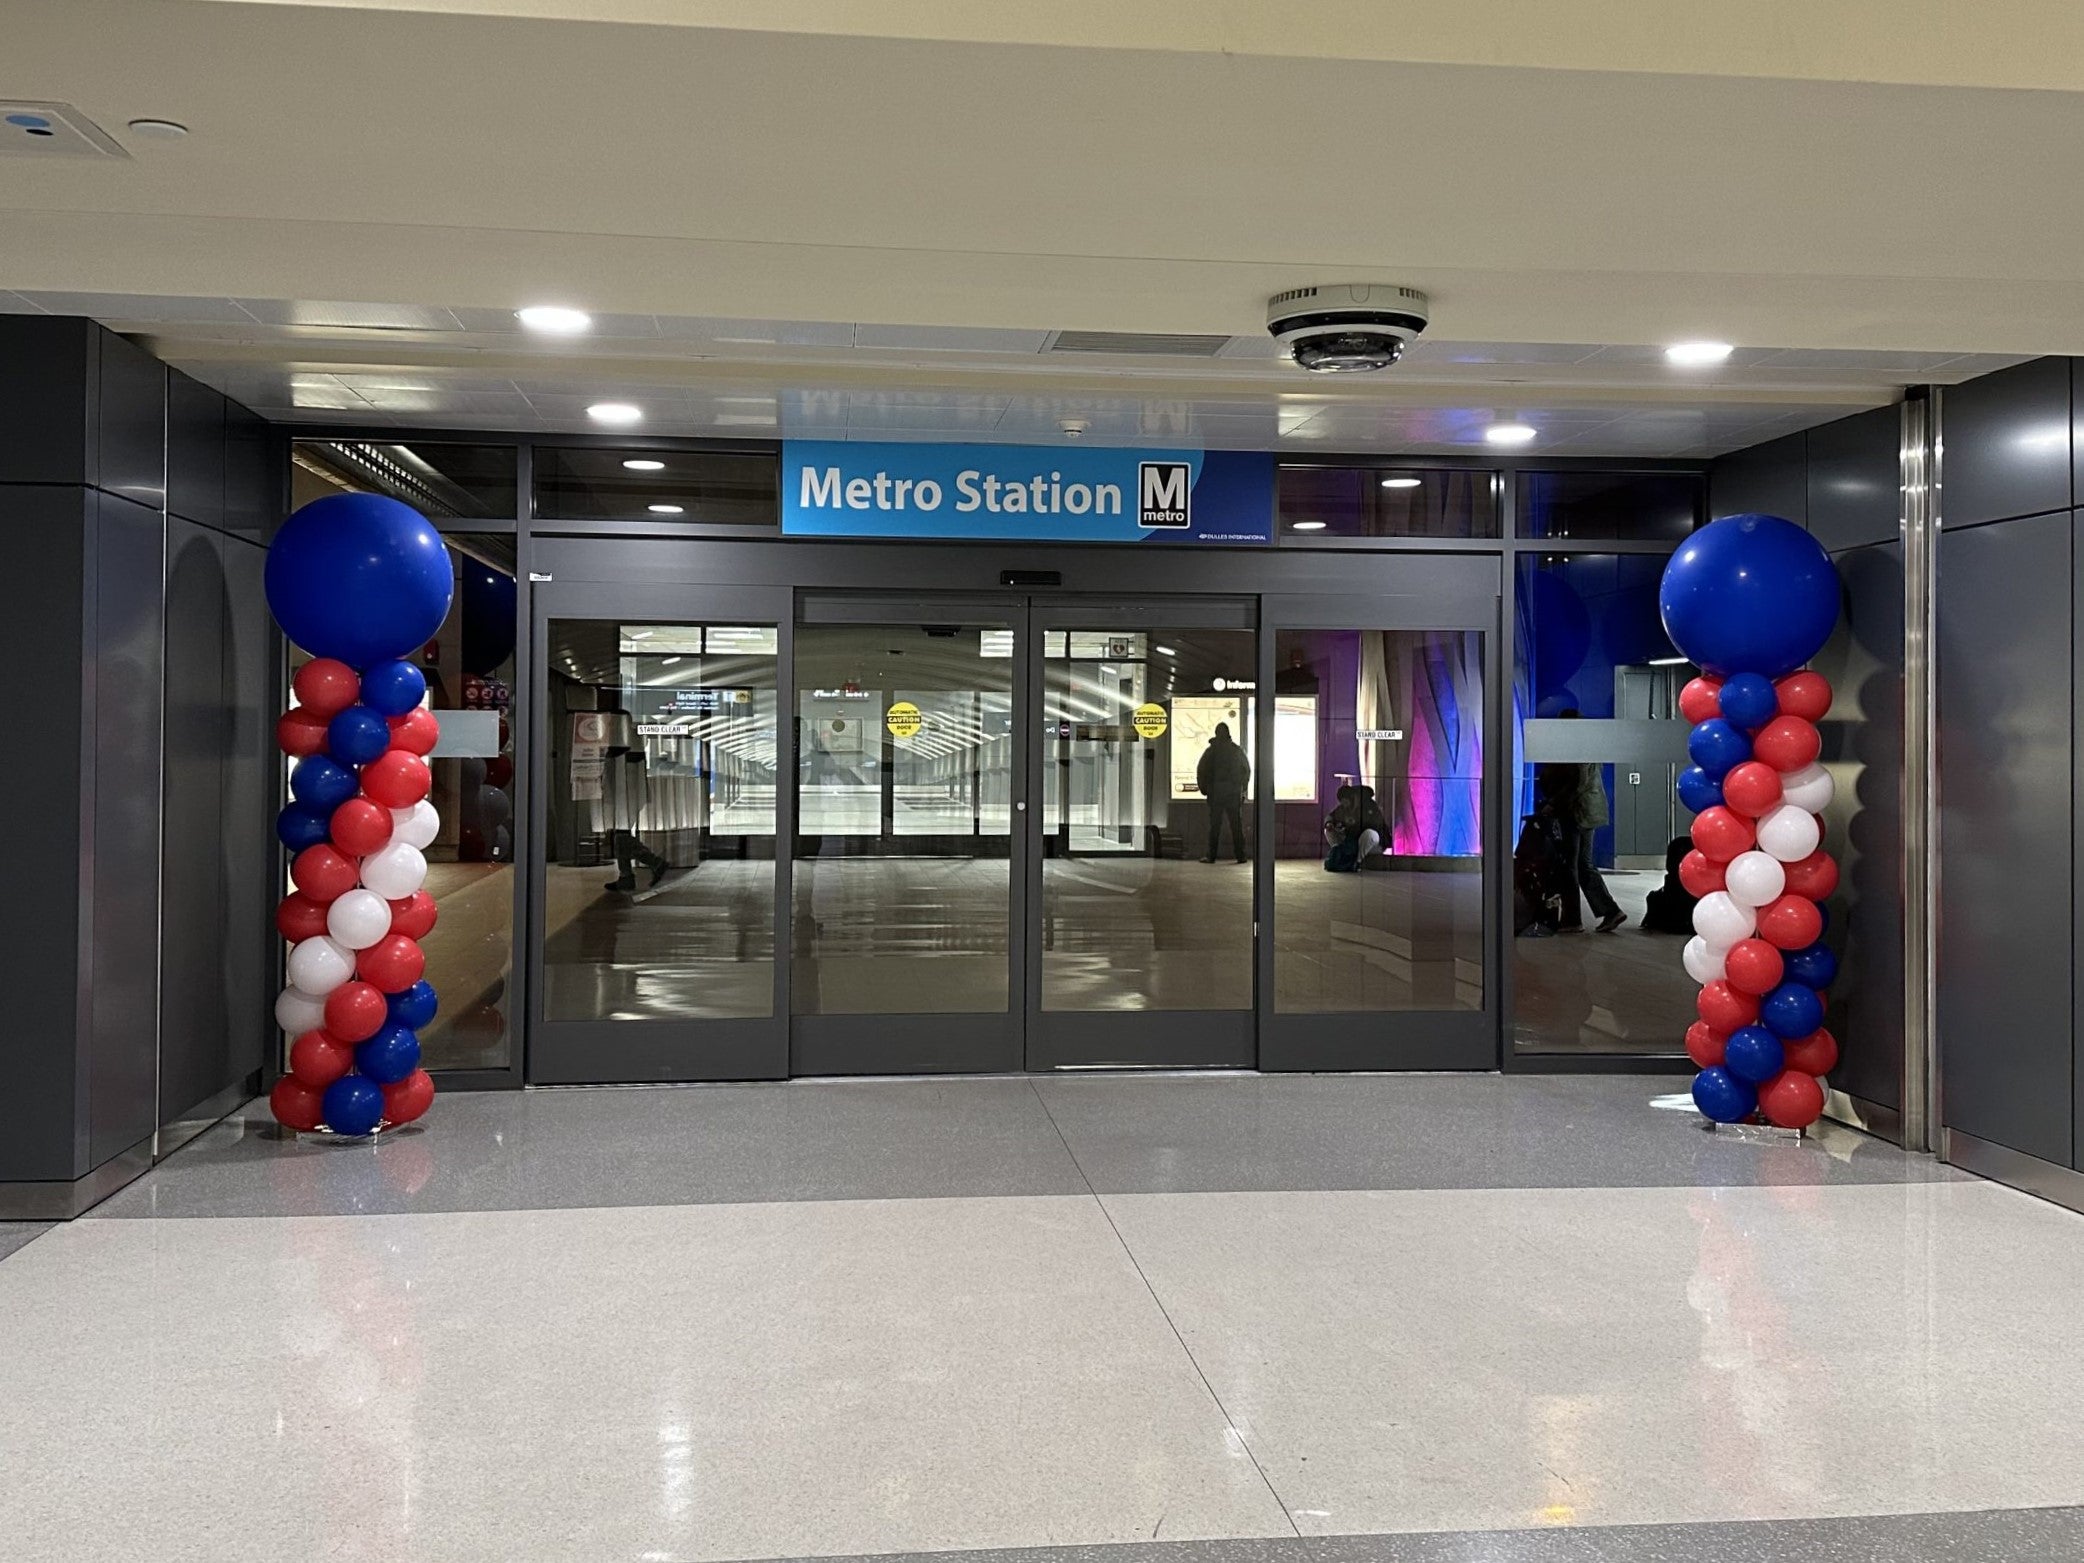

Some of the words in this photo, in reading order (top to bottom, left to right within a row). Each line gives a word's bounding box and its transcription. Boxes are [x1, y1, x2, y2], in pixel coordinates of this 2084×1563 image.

[800, 466, 942, 511] Metro
[955, 470, 1122, 515] Station
[1143, 466, 1186, 510] M
[1143, 510, 1185, 522] metro
